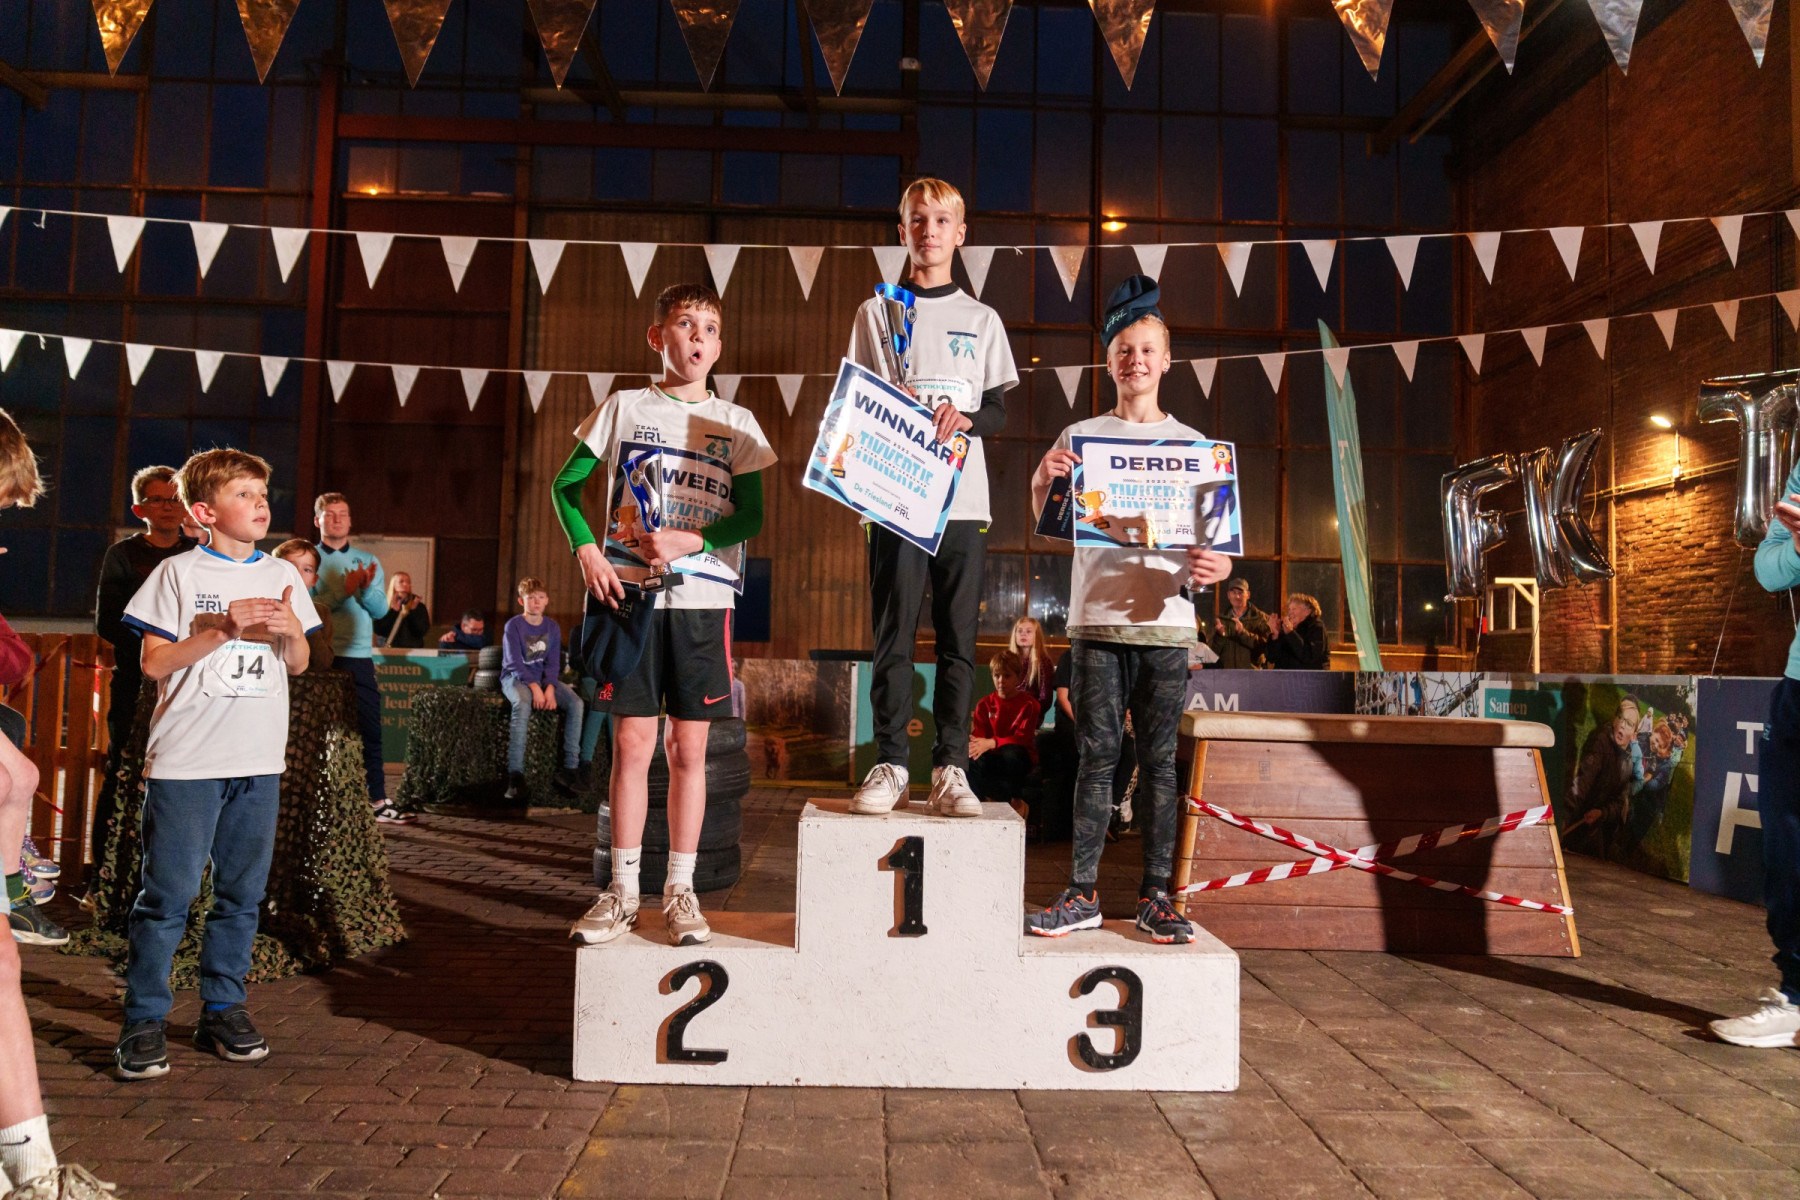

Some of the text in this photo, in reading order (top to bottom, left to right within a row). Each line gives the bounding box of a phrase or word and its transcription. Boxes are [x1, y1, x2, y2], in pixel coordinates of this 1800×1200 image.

[855, 391, 953, 465] WINNAAR
[633, 431, 666, 444] FRL
[1110, 455, 1200, 473] DERDE
[1218, 451, 1226, 459] 3
[662, 468, 735, 503] WEED
[854, 483, 863, 493] De
[865, 488, 893, 510] Friesland
[894, 505, 910, 520] FRL
[1441, 427, 1615, 602] FK
[704, 556, 720, 567] FRL
[195, 601, 229, 612] FRL
[239, 644, 272, 652] TIKKER
[231, 655, 264, 679] J4
[1187, 693, 1239, 711] AM
[1489, 697, 1527, 715] Samen
[888, 837, 927, 934] 1
[666, 961, 729, 1063] 2
[1077, 967, 1142, 1070] 3
